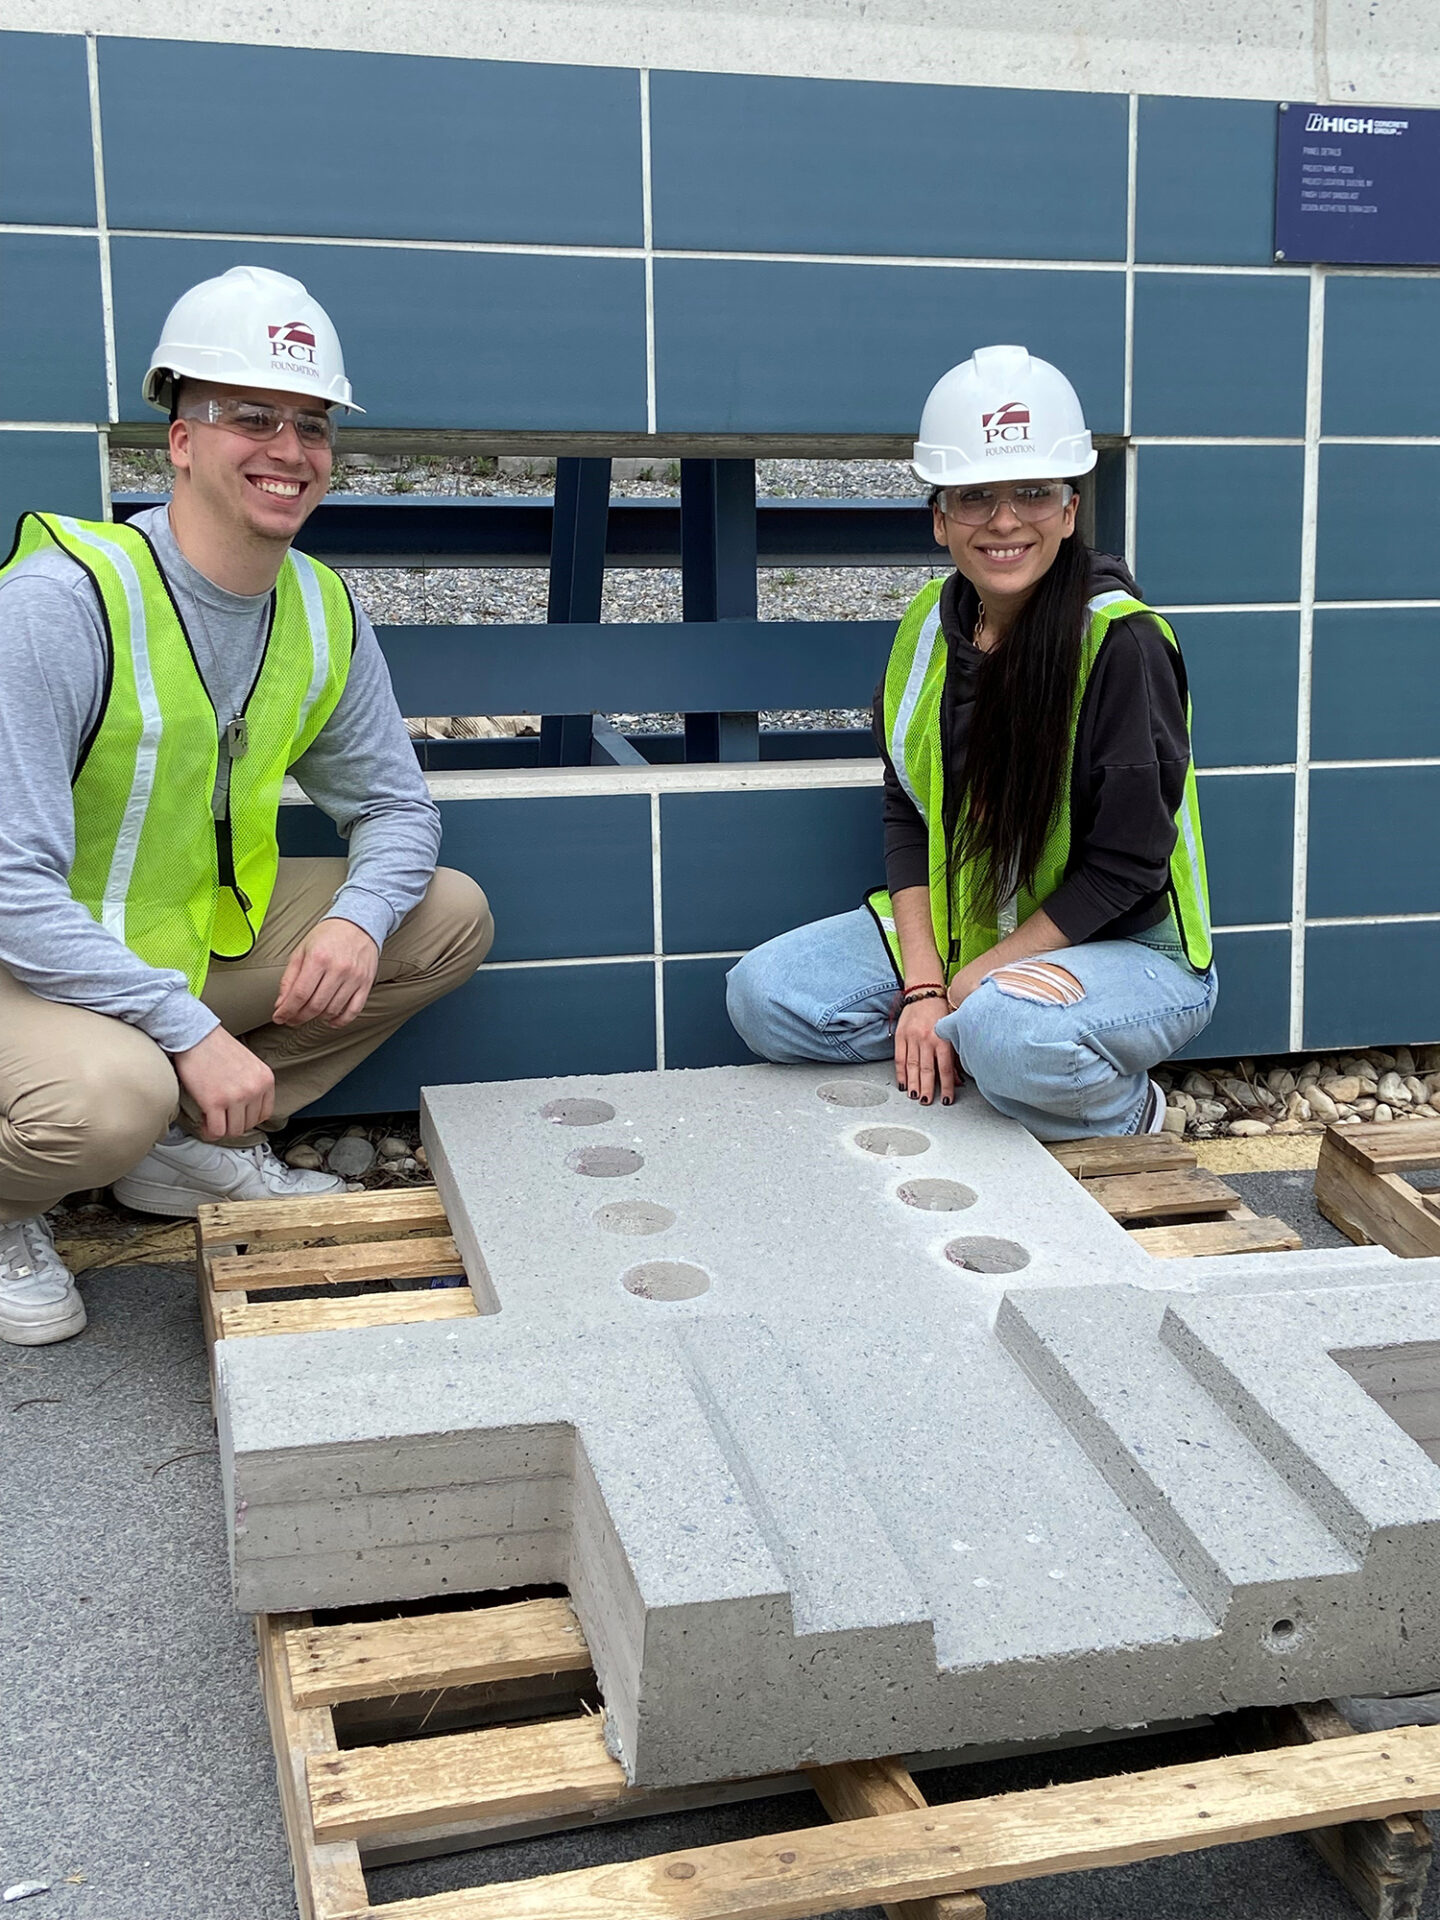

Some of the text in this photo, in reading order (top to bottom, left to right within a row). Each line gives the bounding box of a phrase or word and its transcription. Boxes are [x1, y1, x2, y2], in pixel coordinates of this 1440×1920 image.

[1323, 117, 1373, 134] HIGH
[270, 341, 318, 365] PCI
[271, 360, 320, 379] FOUNDATION
[983, 425, 1033, 444] PCI
[985, 444, 1036, 457] FOUNDATION
